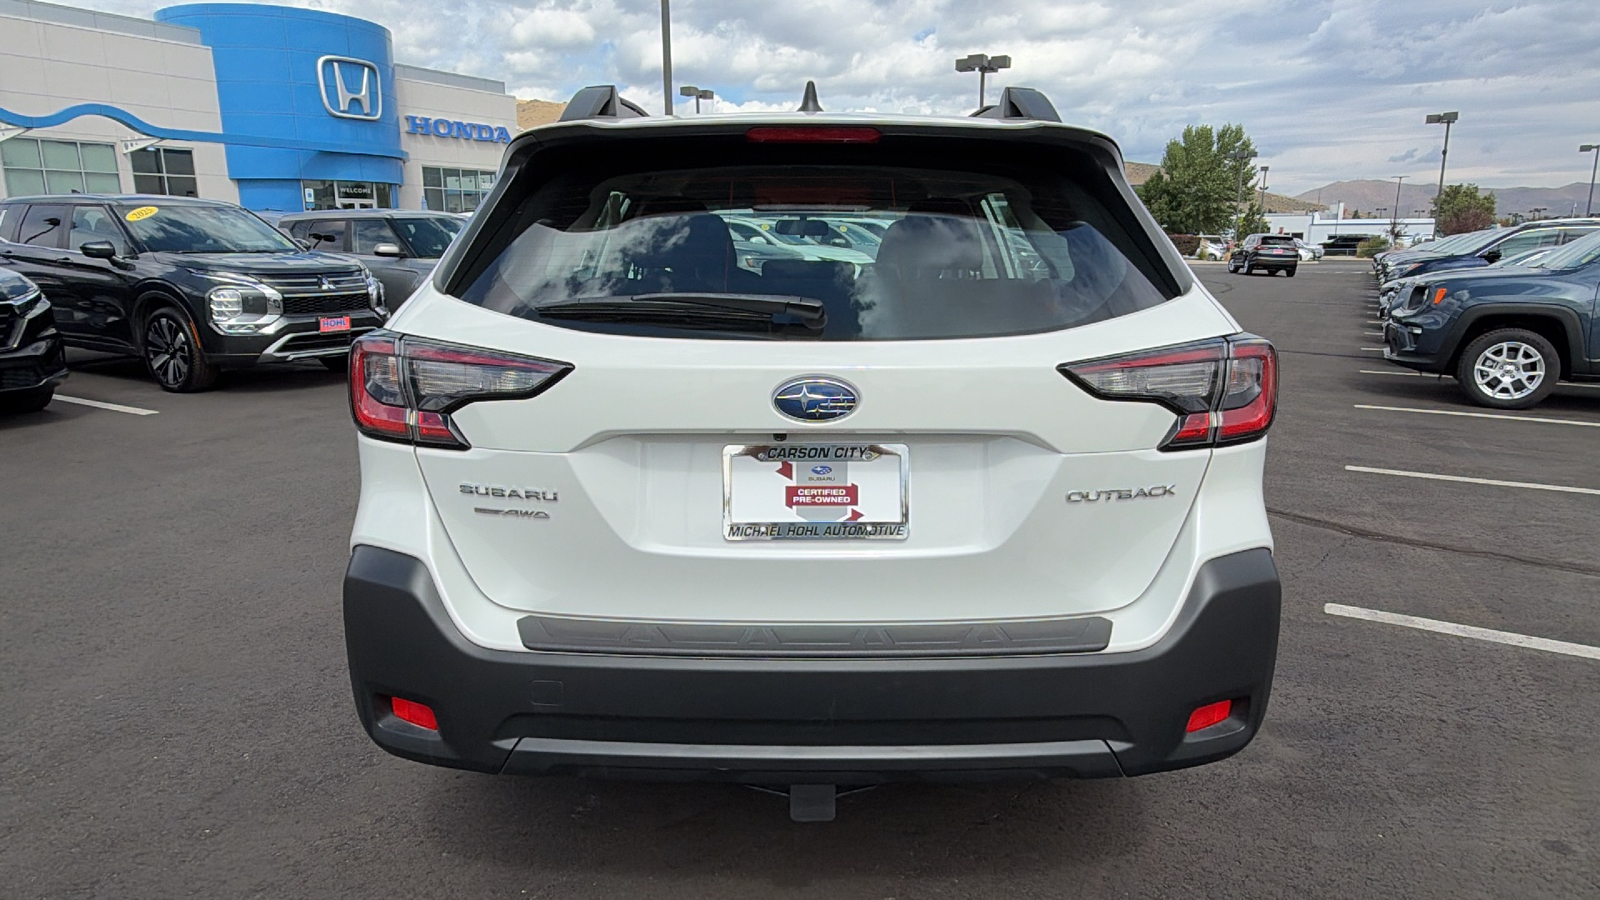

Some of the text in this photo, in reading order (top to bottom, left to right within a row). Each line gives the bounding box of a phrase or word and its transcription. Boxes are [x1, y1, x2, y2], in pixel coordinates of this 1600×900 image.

[404, 114, 512, 144] HONDA
[340, 187, 372, 195] WELCOME
[131, 207, 155, 219] 2025
[322, 319, 347, 328] HOHL
[767, 446, 868, 460] CARSON CITY
[459, 484, 559, 501] SUBARU
[797, 488, 846, 496] CERTIFIED
[1065, 484, 1177, 503] OUTBACK
[501, 508, 550, 519] AWD
[728, 525, 906, 538] MICHAEL HOHL AUTOMOTIVE
